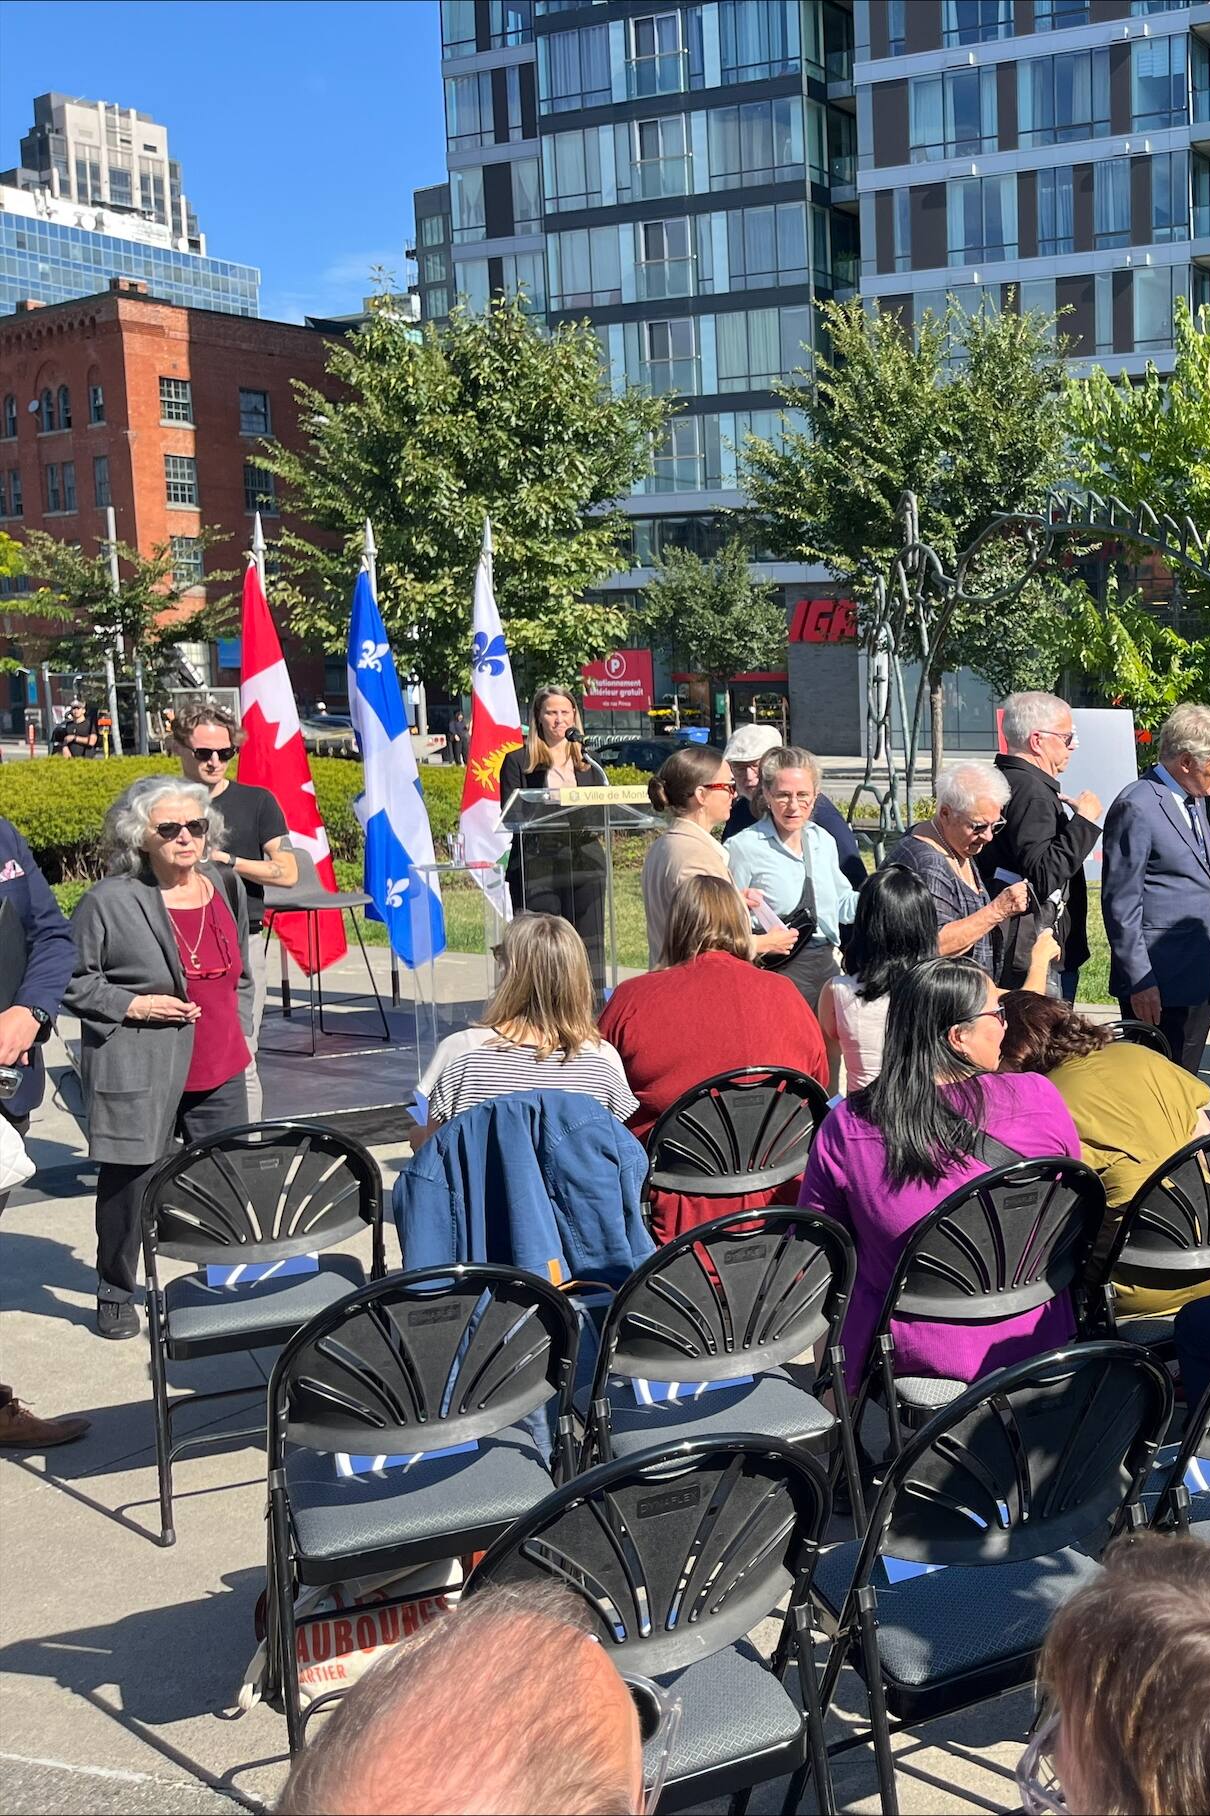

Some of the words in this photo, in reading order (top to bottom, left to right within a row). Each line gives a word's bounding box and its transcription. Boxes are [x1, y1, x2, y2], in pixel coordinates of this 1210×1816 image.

[611, 659, 621, 673] P
[583, 790, 605, 801] Ville
[607, 789, 620, 800] de
